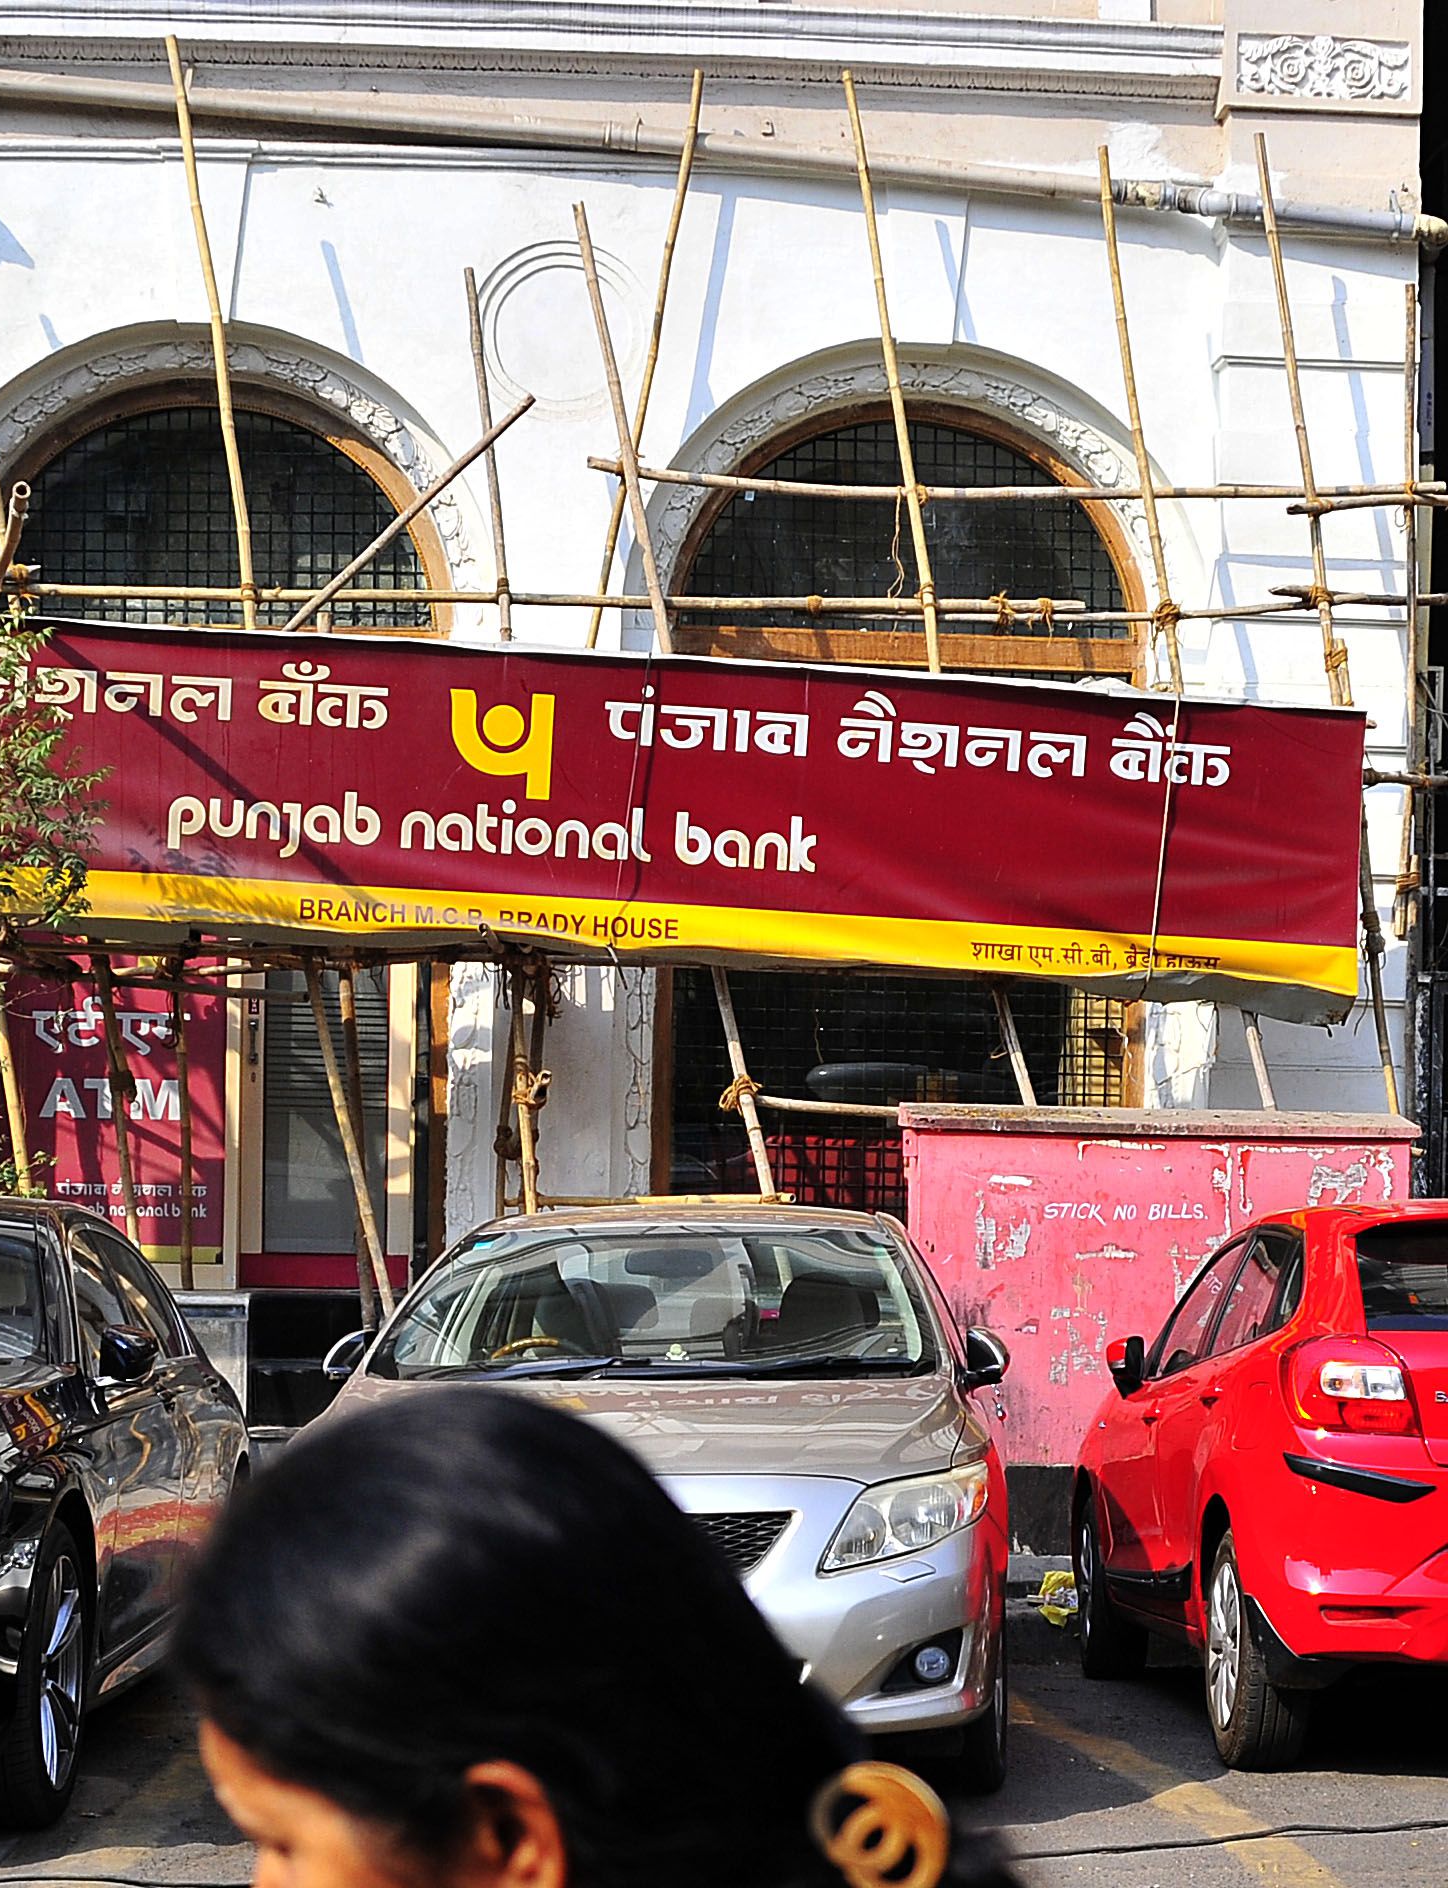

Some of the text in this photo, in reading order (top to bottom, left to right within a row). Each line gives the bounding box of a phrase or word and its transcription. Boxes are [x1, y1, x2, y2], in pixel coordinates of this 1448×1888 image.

[604, 684, 1231, 787] पंजाब नैशनल बैंक
[166, 791, 818, 873] punjab national bank
[299, 898, 406, 923] BRANCH
[499, 910, 586, 935] BRADY
[593, 915, 679, 940] HOUSE
[971, 941, 1023, 962] शाखा
[39, 1077, 181, 1121] ATM
[55, 1178, 106, 1196] पंजाब
[109, 1202, 168, 1217] naonal
[170, 1203, 207, 1218] bnk
[1043, 1202, 1209, 1227] STICK NO BILLS.
